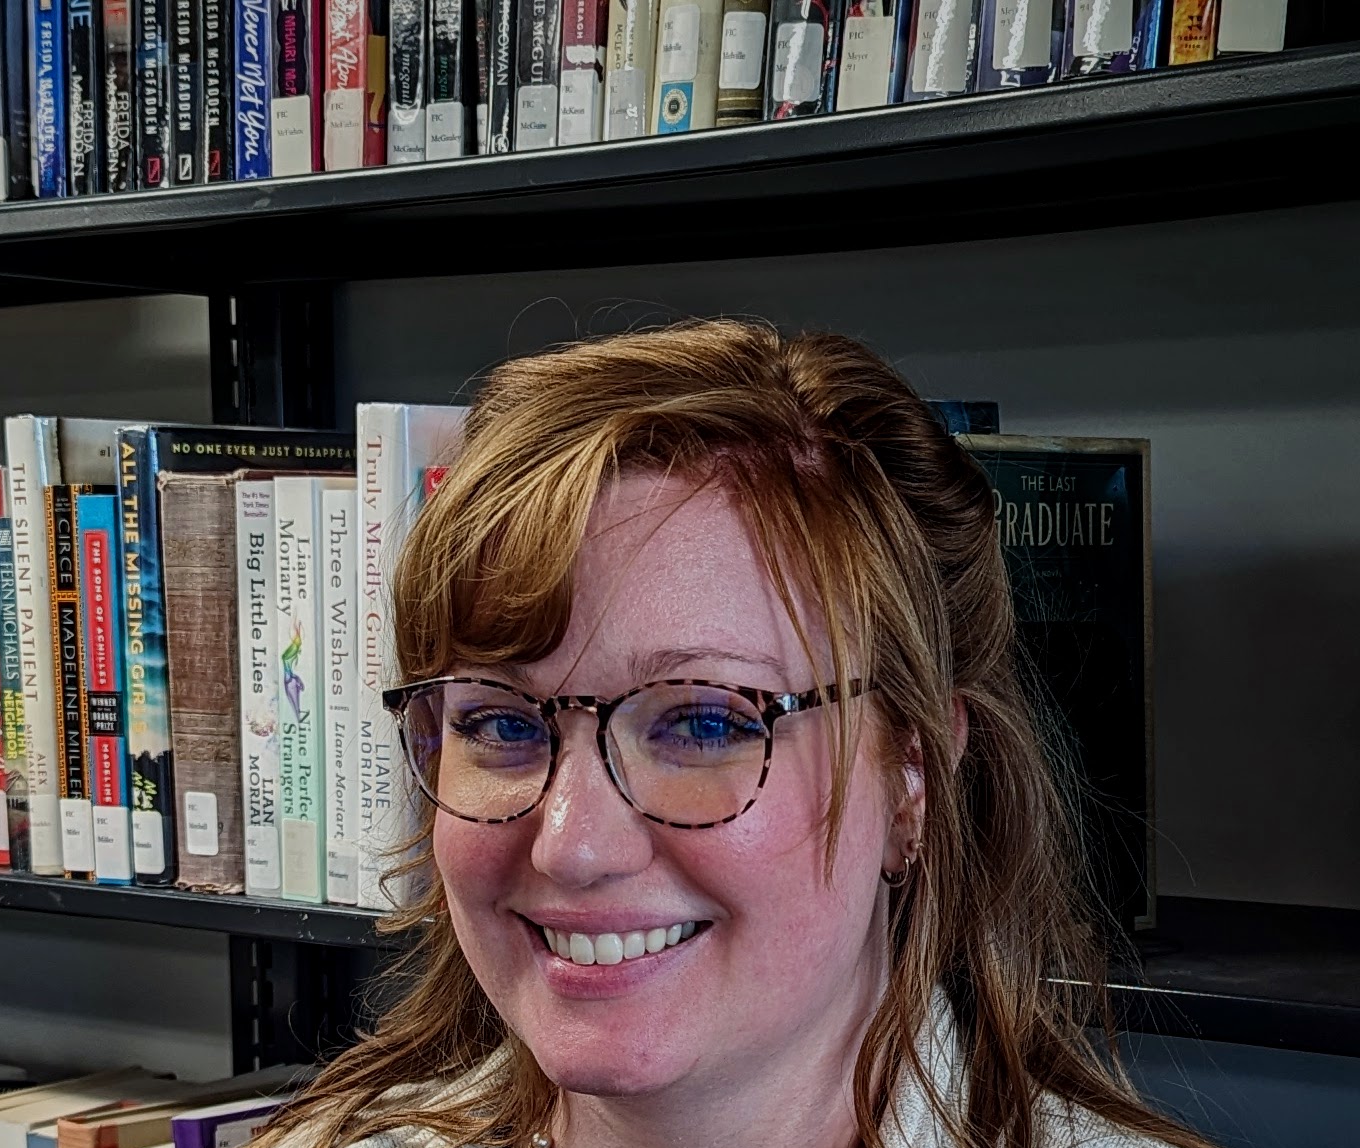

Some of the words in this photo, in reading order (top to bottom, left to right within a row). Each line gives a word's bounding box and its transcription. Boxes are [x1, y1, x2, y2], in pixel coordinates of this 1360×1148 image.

[82, 101, 94, 155] FREIDA
[117, 91, 130, 151] FREIDA
[172, 443, 192, 454] NO
[196, 443, 222, 455] ONE
[227, 445, 257, 457] EVER
[261, 446, 290, 458] JUST
[363, 435, 382, 511] Truly
[1021, 475, 1045, 492] THE
[1049, 476, 1077, 492] LAST
[12, 463, 27, 506] THE
[15, 519, 32, 596] SILENT
[57, 519, 73, 584] CIRCE
[249, 532, 265, 572] Big
[278, 518, 295, 617] Moriarty
[297, 536, 309, 600] Liane
[329, 510, 346, 588] Three
[365, 521, 382, 603] Madly
[252, 578, 268, 641] Little
[21, 609, 39, 703] PATIENT
[61, 607, 79, 723] MADELINE
[252, 646, 267, 695] Lies
[331, 599, 348, 696] Wishes
[365, 610, 382, 692] Guilty
[283, 723, 298, 815] Strangers
[377, 743, 391, 810] LIANE
